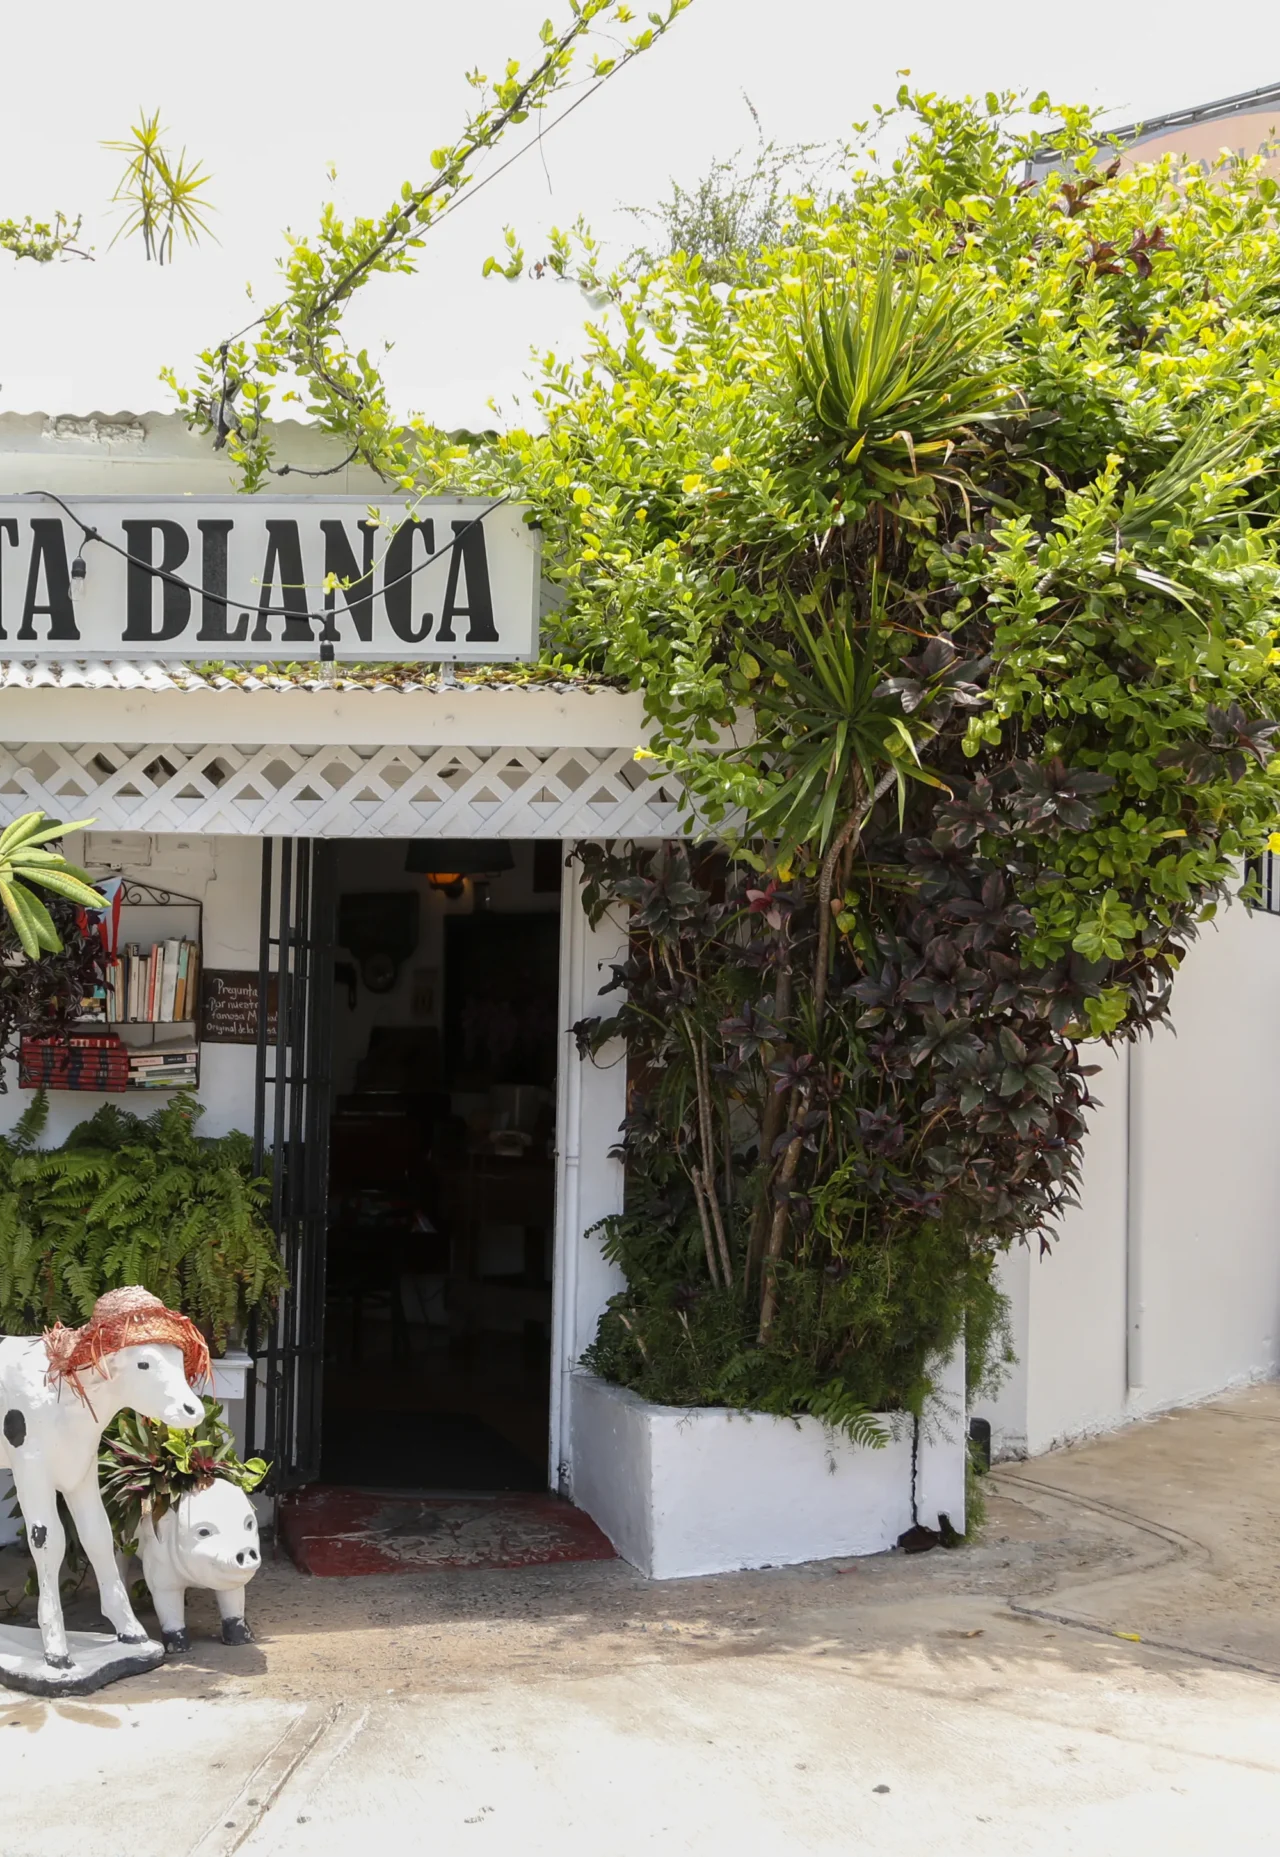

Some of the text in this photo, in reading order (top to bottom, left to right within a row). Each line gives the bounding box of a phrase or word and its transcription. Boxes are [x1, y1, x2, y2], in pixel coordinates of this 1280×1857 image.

[120, 516, 500, 644] BLANCA
[213, 978, 259, 1000] Pregunta
[208, 997, 259, 1011] Por nuestr
[206, 1021, 237, 1035] Original
